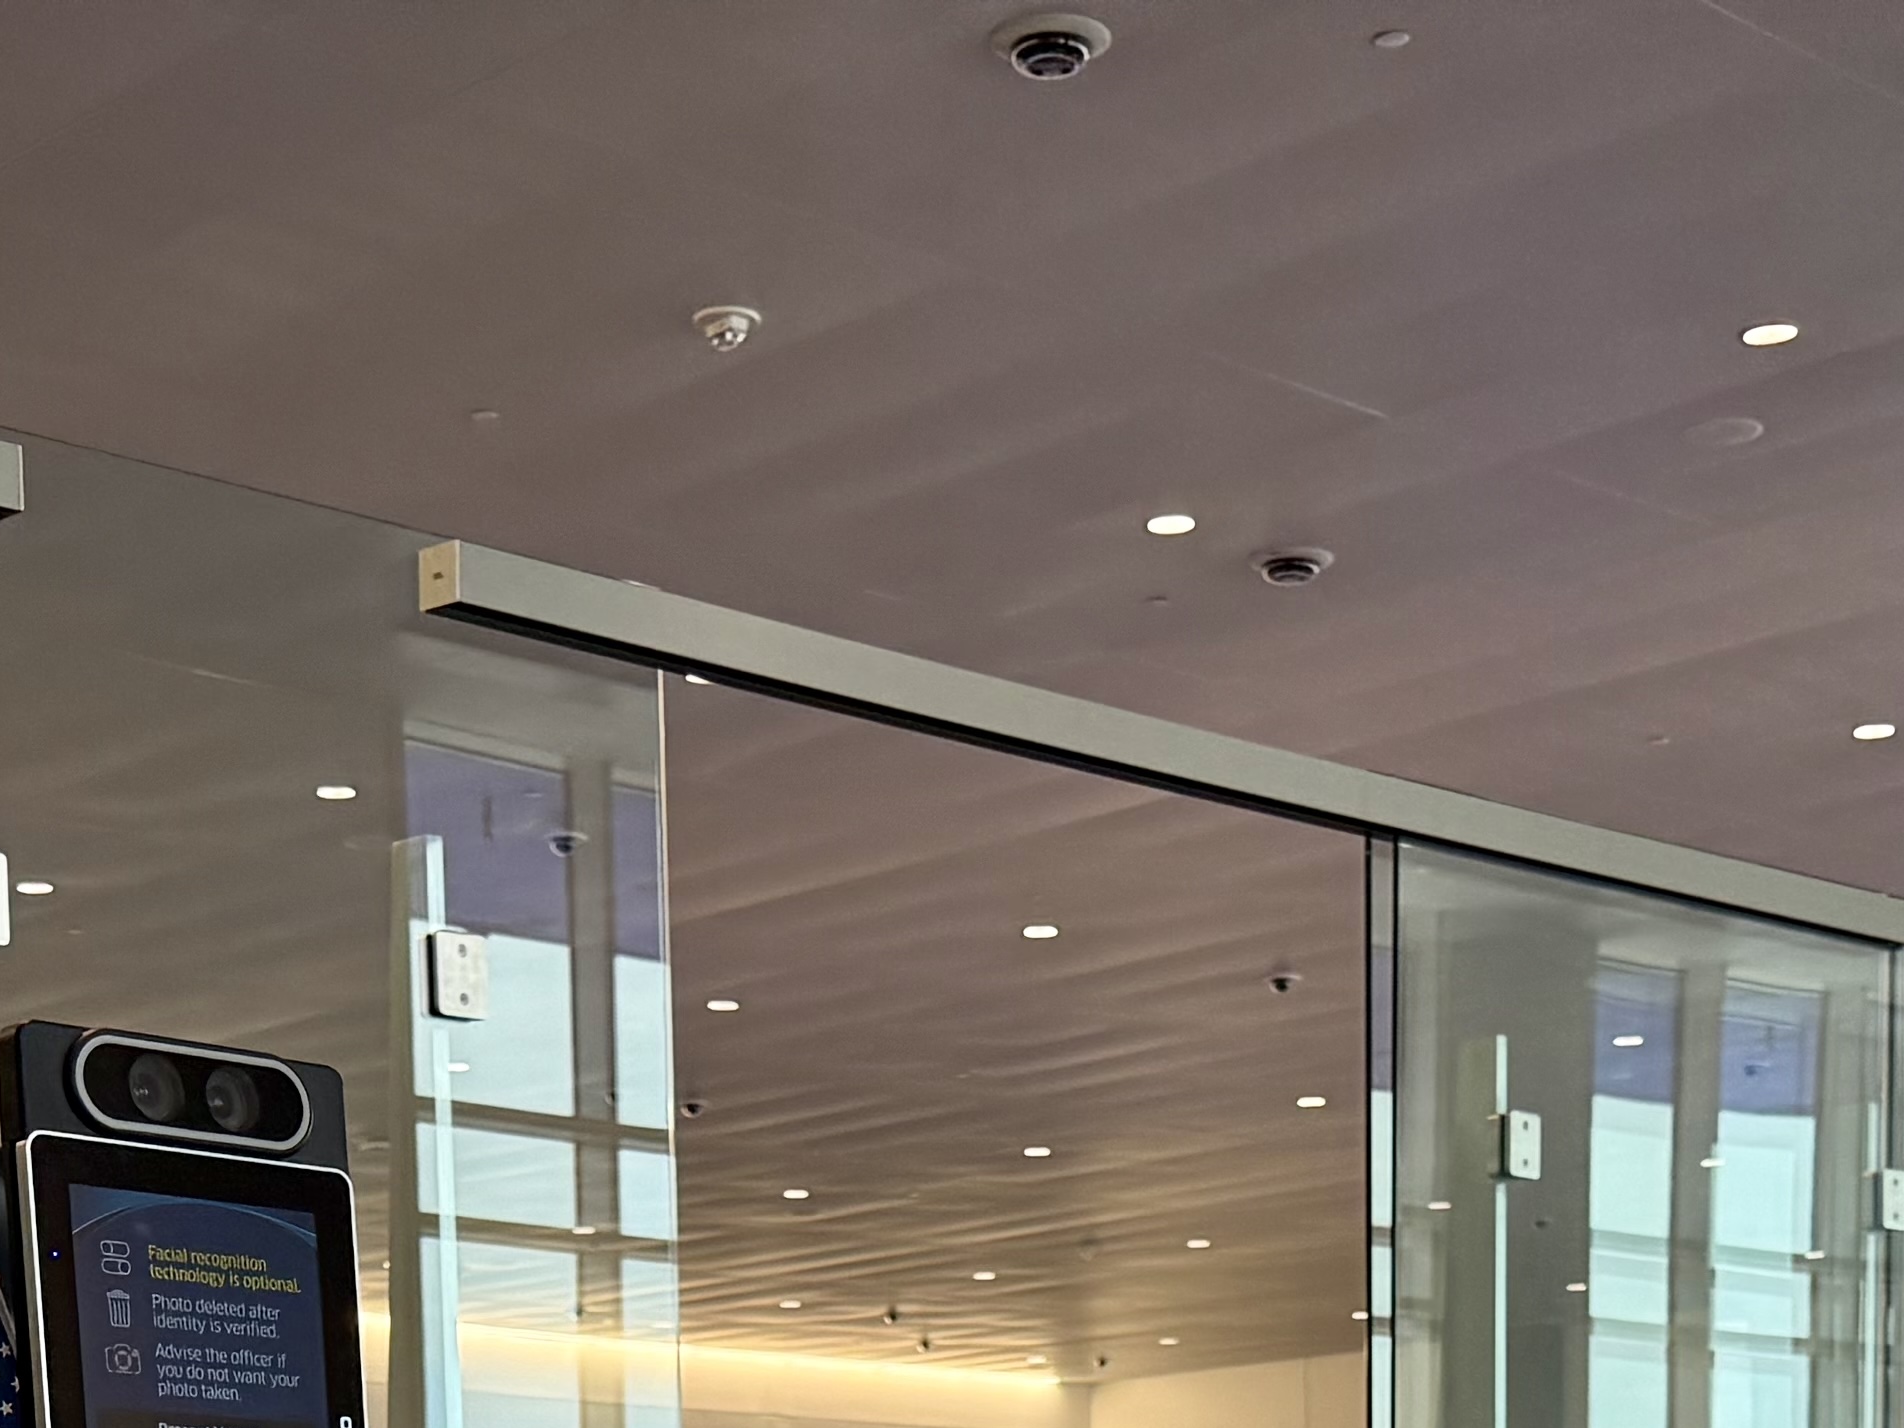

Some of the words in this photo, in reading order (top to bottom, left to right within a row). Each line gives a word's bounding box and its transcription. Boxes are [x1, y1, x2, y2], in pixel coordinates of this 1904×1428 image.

[148, 1244, 188, 1263] Facial
[191, 1252, 267, 1272] recognition
[149, 1264, 226, 1288] technology
[229, 1271, 240, 1287] is
[243, 1275, 302, 1294] optional.
[151, 1294, 193, 1312] Photo
[196, 1299, 246, 1318] deleted
[248, 1304, 281, 1321] after
[153, 1313, 206, 1335] identity
[210, 1319, 222, 1333] is
[224, 1322, 280, 1339] verified.
[155, 1343, 202, 1361] Advise
[205, 1347, 228, 1363] the
[230, 1349, 274, 1367] officer
[277, 1353, 287, 1368] if
[156, 1364, 183, 1380] you
[186, 1363, 205, 1380] do
[207, 1366, 230, 1383] not
[232, 1368, 266, 1385] want
[269, 1373, 300, 1388] your
[158, 1382, 198, 1398] photo
[201, 1384, 243, 1401] taken.
